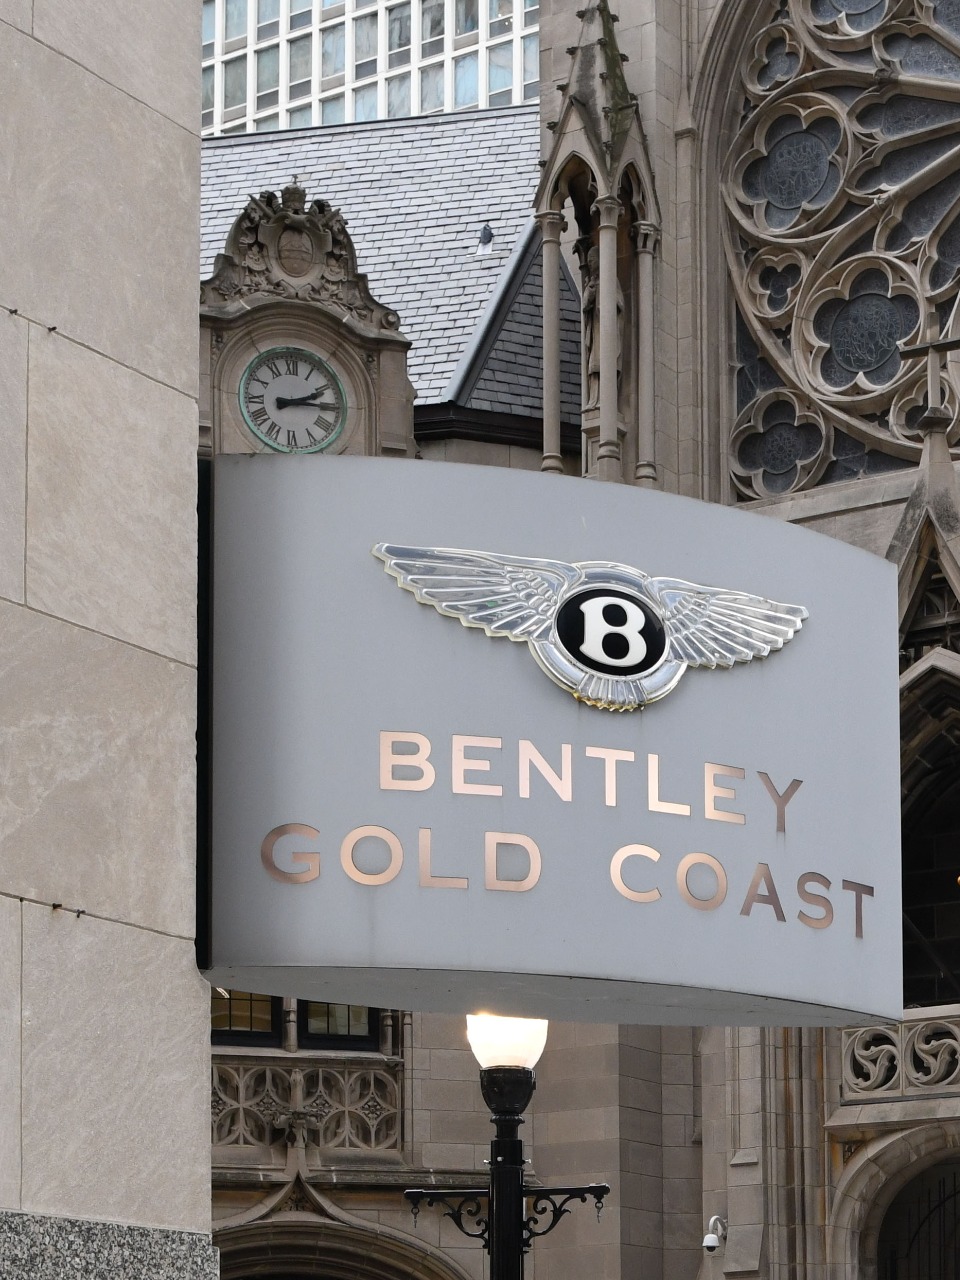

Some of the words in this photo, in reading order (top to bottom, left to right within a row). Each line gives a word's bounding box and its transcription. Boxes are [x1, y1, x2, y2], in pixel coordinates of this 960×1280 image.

[266, 362, 282, 379] XI
[285, 360, 298, 376] XII
[305, 367, 315, 381] I
[253, 377, 269, 389] X
[248, 393, 264, 404] IX
[251, 407, 270, 426] VIII
[266, 421, 281, 440] VII
[287, 430, 297, 446] VI
[306, 428, 317, 443] V
[579, 596, 648, 667] B
[379, 731, 804, 834] BENTLEY
[260, 823, 542, 893] GOLD
[610, 843, 874, 939] COAST
